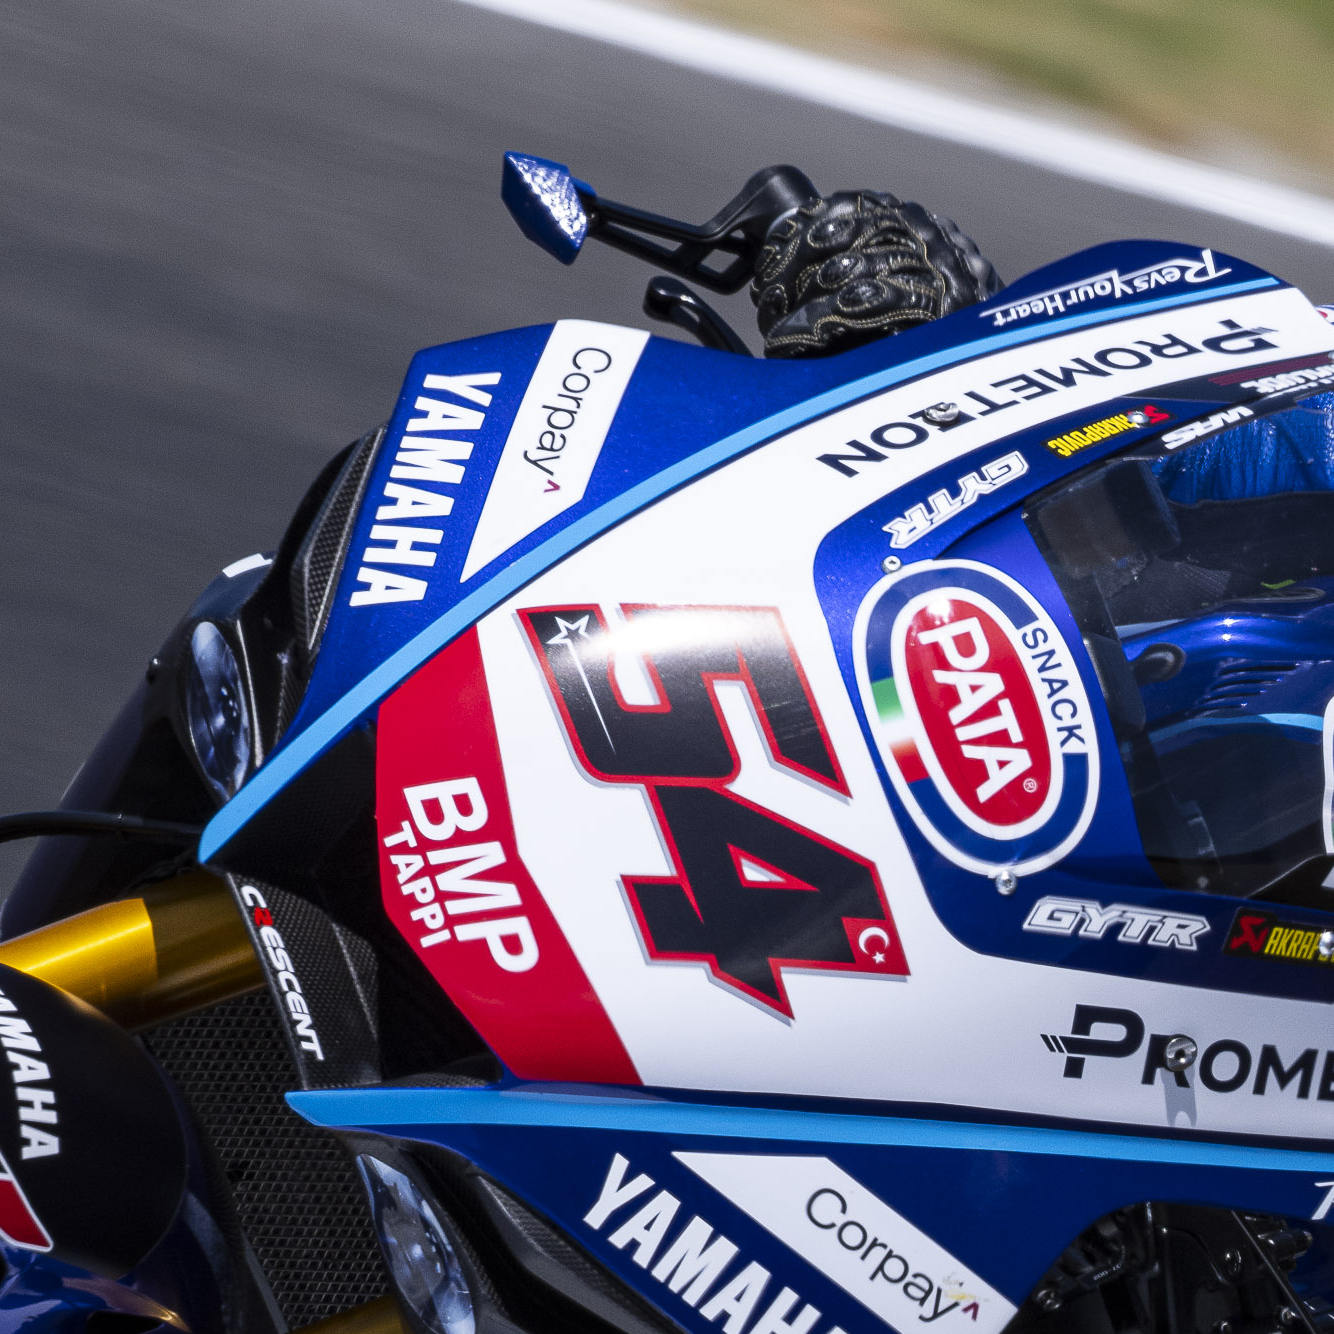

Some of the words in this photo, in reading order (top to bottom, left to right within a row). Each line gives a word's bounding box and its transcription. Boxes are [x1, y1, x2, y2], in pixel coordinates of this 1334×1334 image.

[524, 347, 612, 476] Corpay
[349, 371, 501, 606] YAMAHA
[883, 450, 1030, 548] GYTR
[917, 617, 1033, 803] PATA
[1021, 626, 1087, 747] SNACK
[402, 776, 540, 973] BMP
[516, 602, 910, 1018] 54
[384, 820, 450, 947] TAPPI
[1023, 895, 1210, 951] GYTR
[803, 1187, 960, 1324] Corpay
